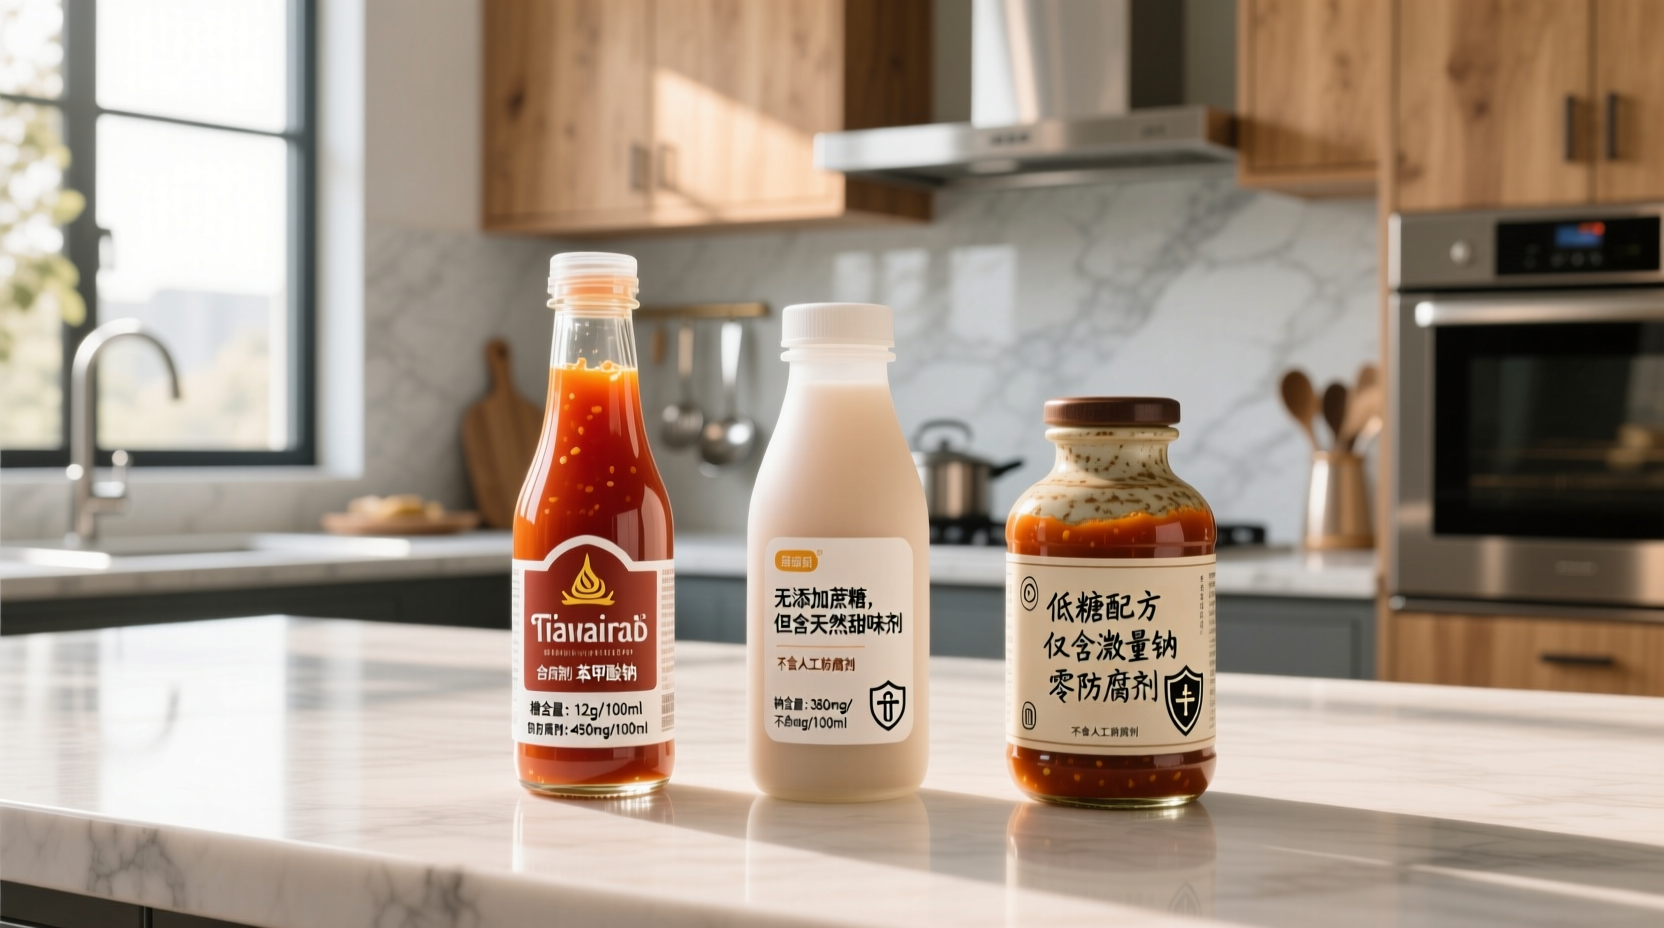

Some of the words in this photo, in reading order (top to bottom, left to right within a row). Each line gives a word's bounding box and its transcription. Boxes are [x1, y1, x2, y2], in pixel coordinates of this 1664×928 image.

[1046, 590, 1161, 624] 低糖配方
[774, 612, 903, 635] 但含天然甜味剂
[1049, 668, 1158, 704] 零防腐剂
[574, 701, 643, 721] 12g/100ml
